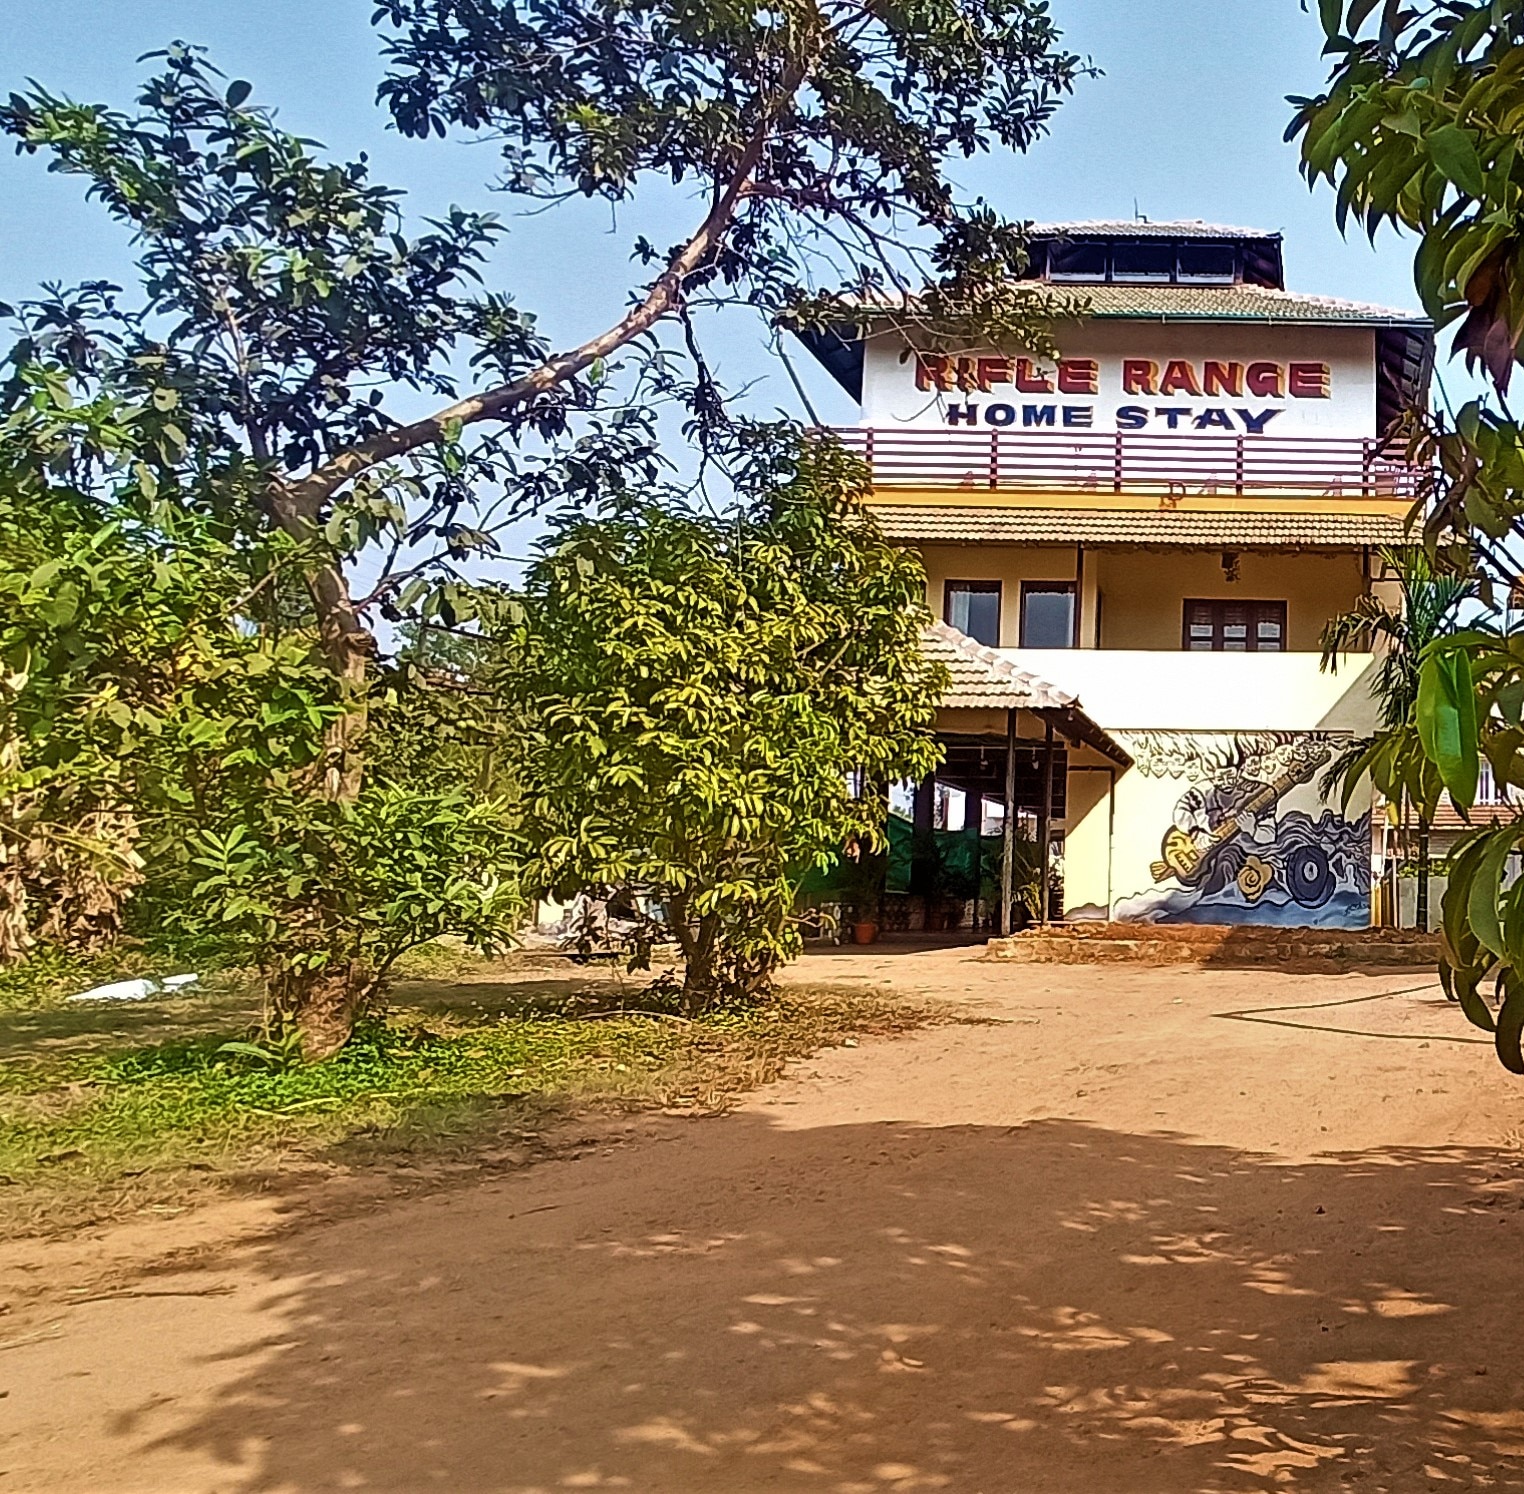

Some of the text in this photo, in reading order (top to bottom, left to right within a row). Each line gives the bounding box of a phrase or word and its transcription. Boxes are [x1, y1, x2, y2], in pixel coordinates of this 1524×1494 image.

[914, 356, 1333, 399] RIFLE RANGE
[946, 403, 1285, 434] HOME STAY
